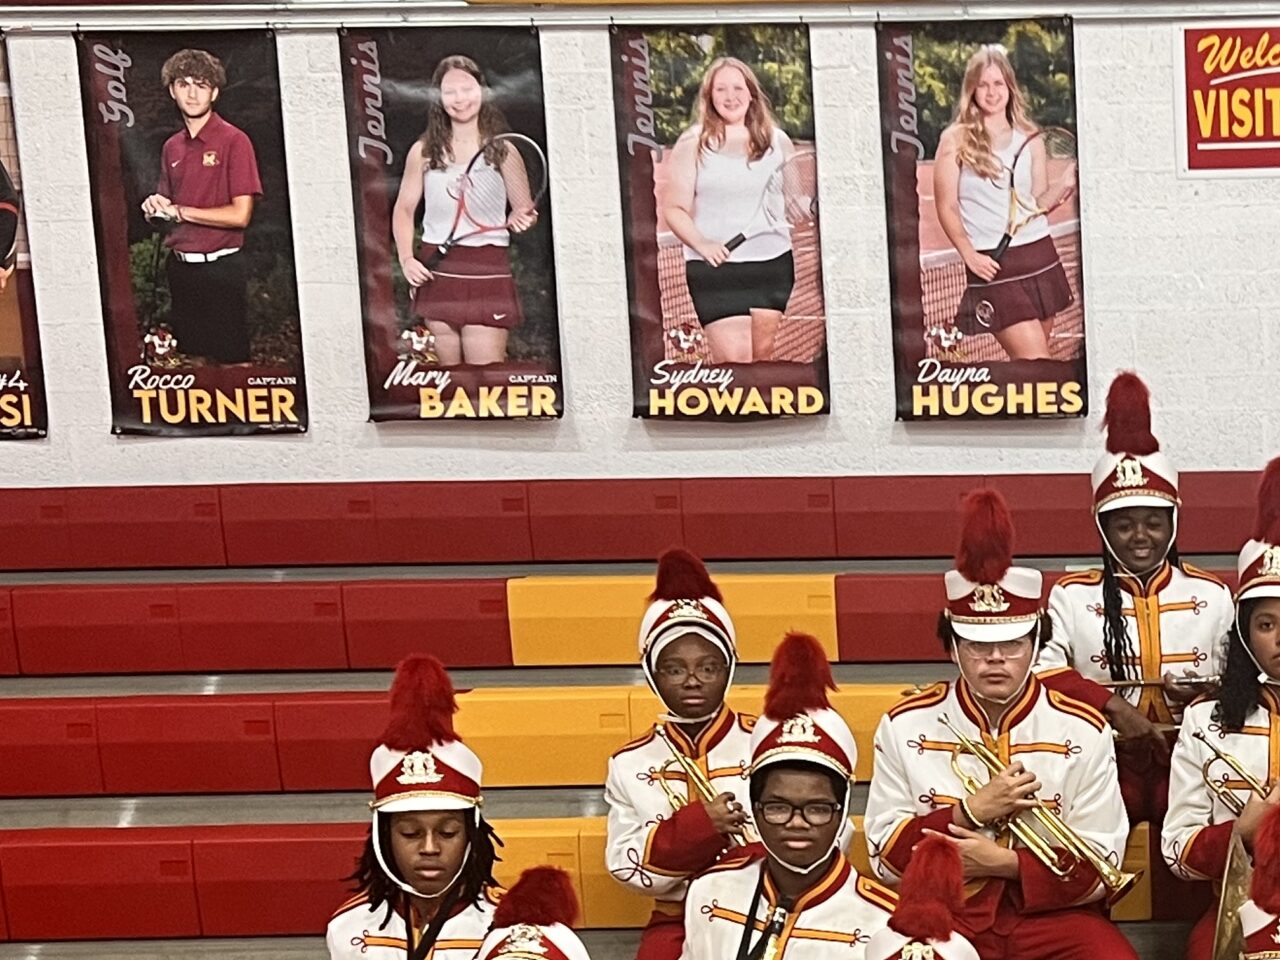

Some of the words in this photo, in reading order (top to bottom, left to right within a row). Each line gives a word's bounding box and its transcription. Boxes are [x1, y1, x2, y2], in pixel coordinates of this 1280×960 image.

[93, 43, 133, 127] Golf
[622, 37, 663, 160] Tennis
[887, 34, 925, 159] Tennis
[353, 40, 392, 164] Tennis
[127, 365, 195, 390] Rocco
[247, 377, 297, 386] CAPTAIN
[384, 361, 451, 393] Mary
[509, 375, 557, 383] CAPTAIN
[650, 360, 734, 392] Sydney
[917, 358, 991, 392] Dayna
[133, 388, 298, 424] TURNER
[419, 385, 558, 418] BAKER
[649, 386, 824, 416] HOWARD
[912, 381, 1083, 416] HUGHES
